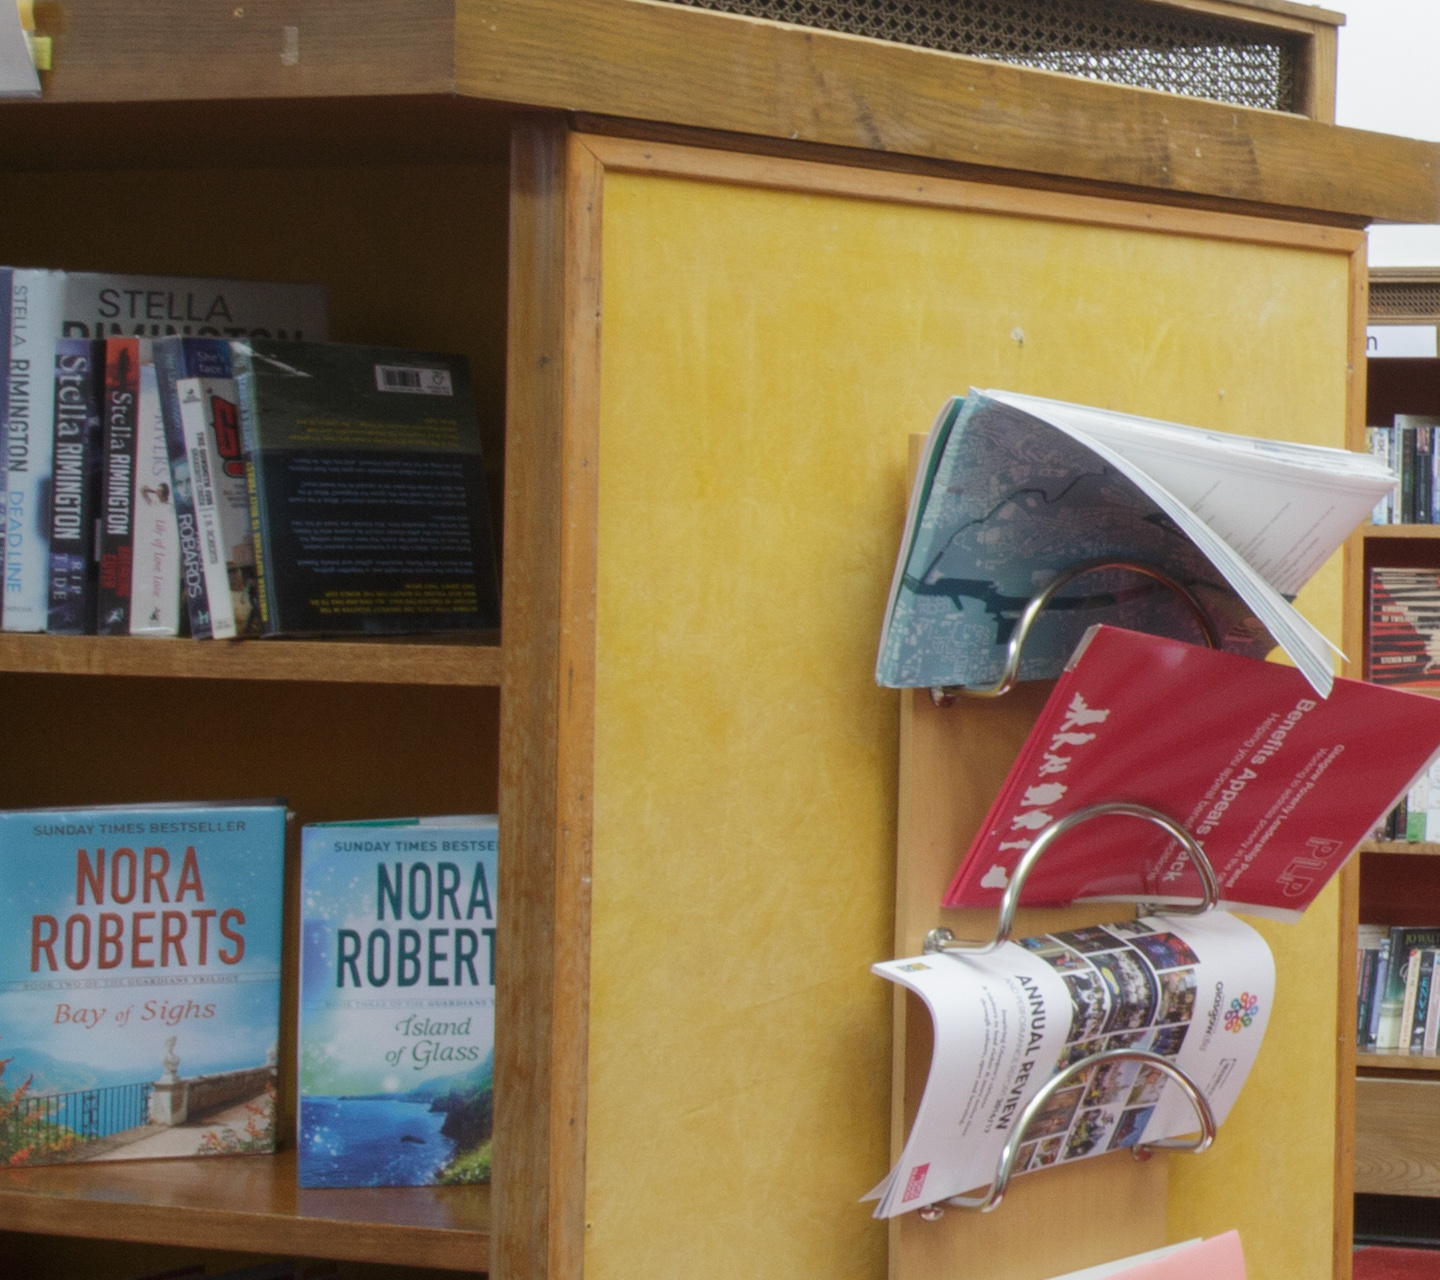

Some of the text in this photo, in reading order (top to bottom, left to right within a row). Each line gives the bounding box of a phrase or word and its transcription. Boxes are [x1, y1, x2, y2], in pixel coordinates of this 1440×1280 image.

[99, 288, 233, 321] STELLA
[6, 285, 30, 593] STELLA RIMINGTON DEADLINE
[53, 354, 88, 540] Stella RIMINGTON
[106, 391, 133, 536] Stella RIMINGTON
[1196, 698, 1316, 836] Benefits Appeals
[33, 820, 247, 837] SUNDAY TIMES BESTSELLER
[76, 846, 205, 906] NORA
[378, 861, 494, 920] NORA
[30, 908, 247, 973] ROBERTS
[54, 1000, 216, 1029] Bay of Sighs
[395, 1014, 471, 1039] Island
[385, 1040, 479, 1070] of Glass
[995, 974, 1045, 1131] ANNUAL REVIEW
